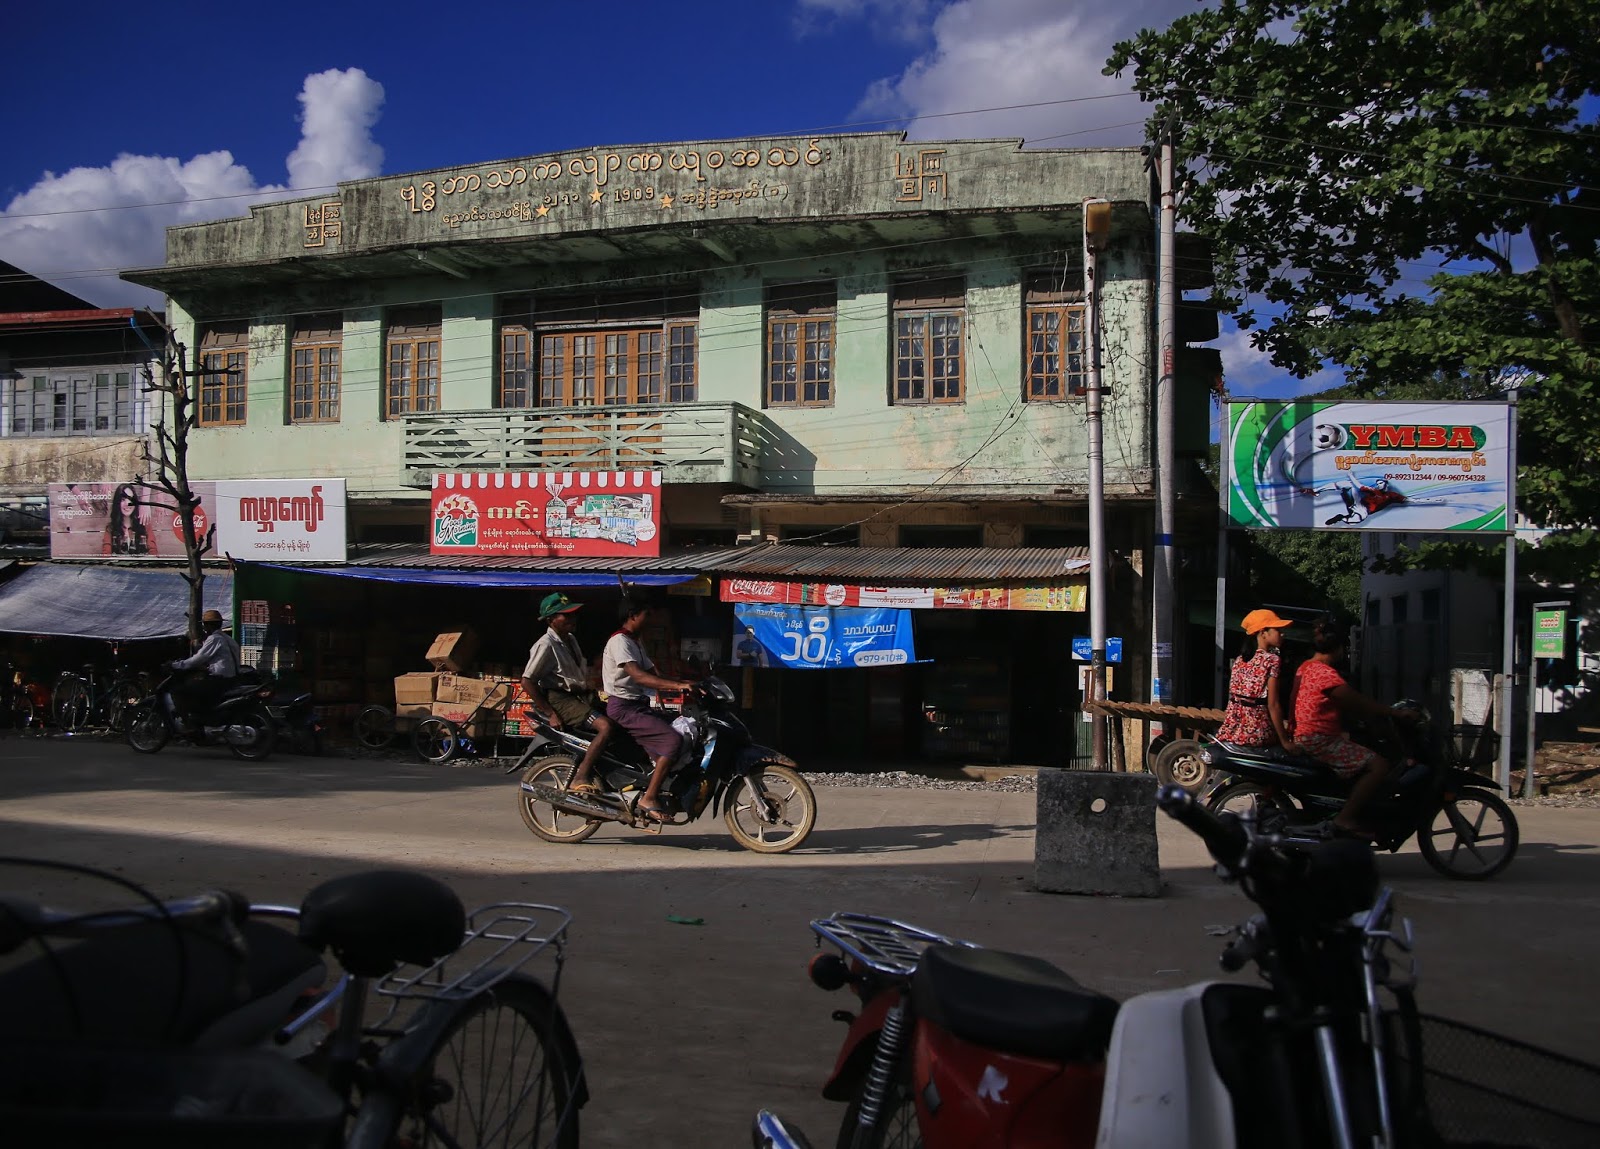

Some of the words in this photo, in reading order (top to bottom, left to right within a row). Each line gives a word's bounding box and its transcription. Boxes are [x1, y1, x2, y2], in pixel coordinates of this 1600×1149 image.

[613, 186, 655, 203] 1909
[1349, 425, 1476, 448] YMBA
[239, 485, 324, 533] ကမ္ဘာကျော်
[437, 522, 477, 545] Morning
[440, 514, 463, 531] Good
